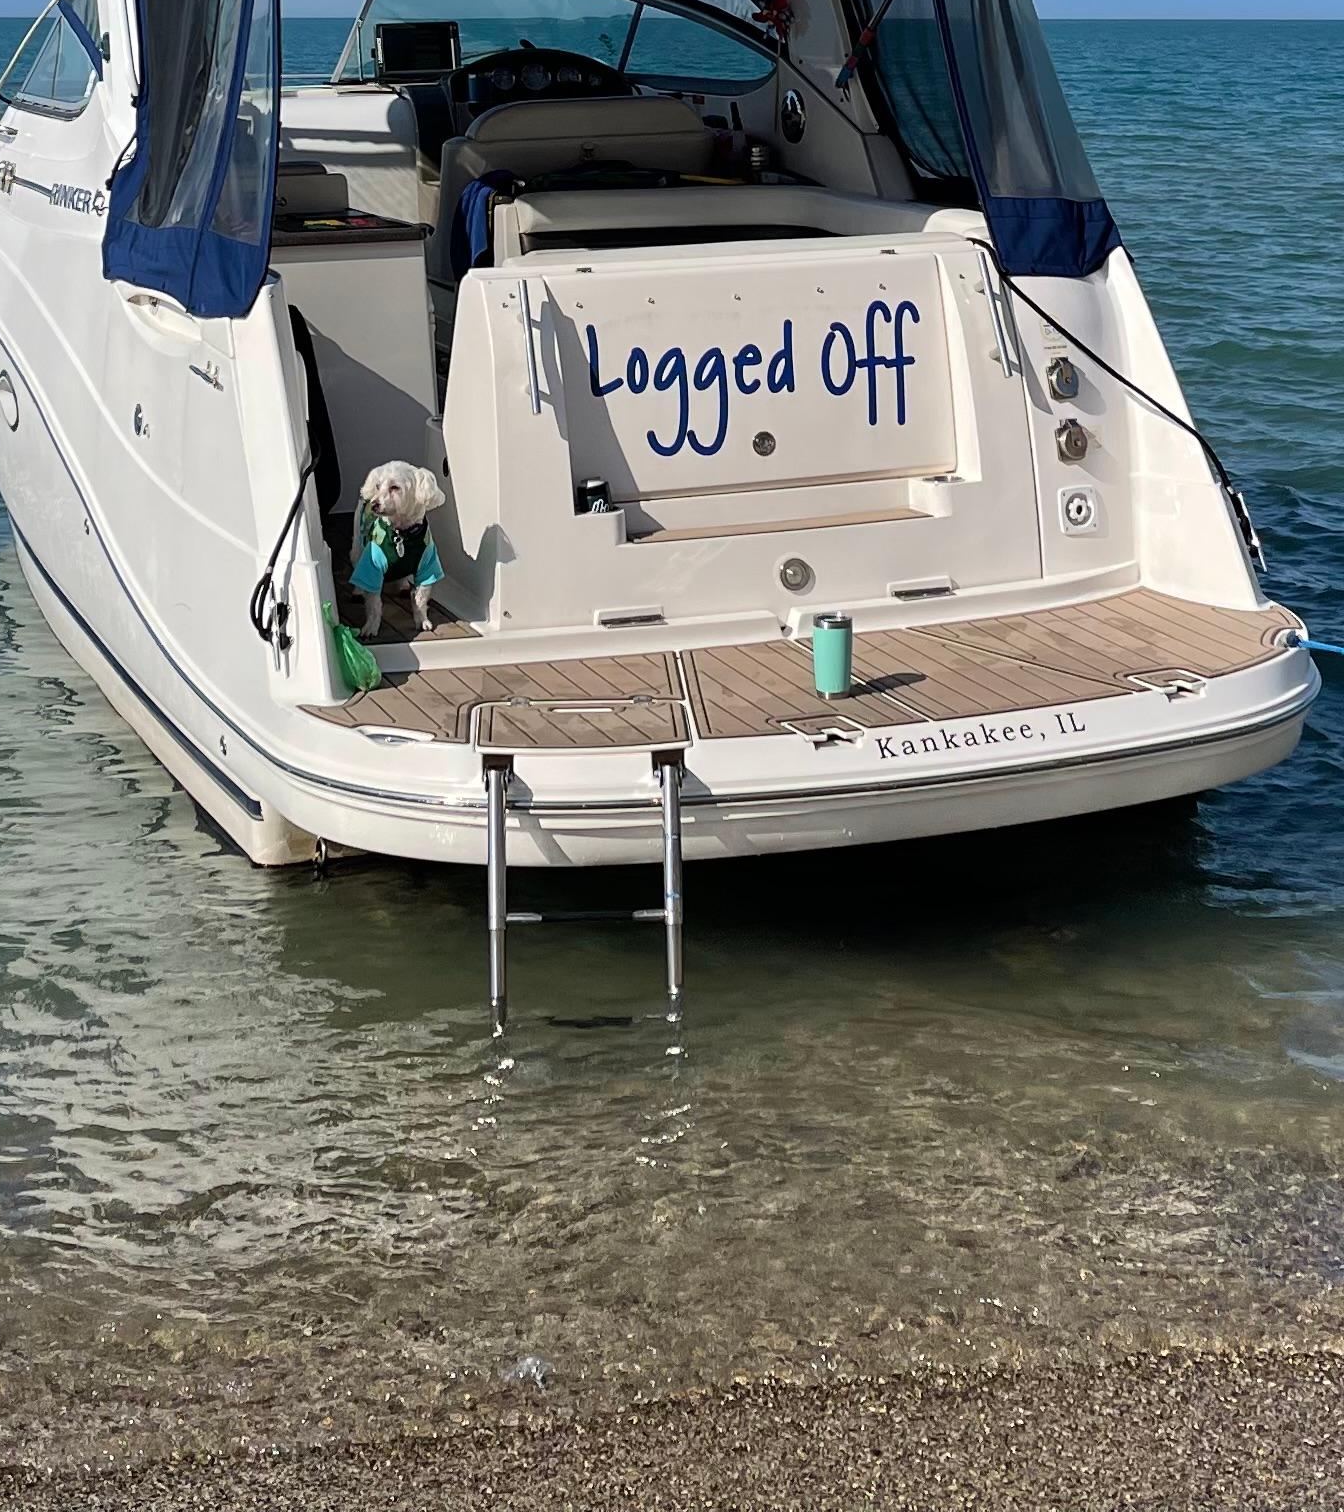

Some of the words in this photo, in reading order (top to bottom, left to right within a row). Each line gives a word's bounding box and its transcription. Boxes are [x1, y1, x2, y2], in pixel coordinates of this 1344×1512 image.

[586, 319, 795, 456] Logged
[821, 300, 920, 426] Off
[875, 723, 1045, 759] Kankakee,
[1054, 712, 1086, 734] IL
